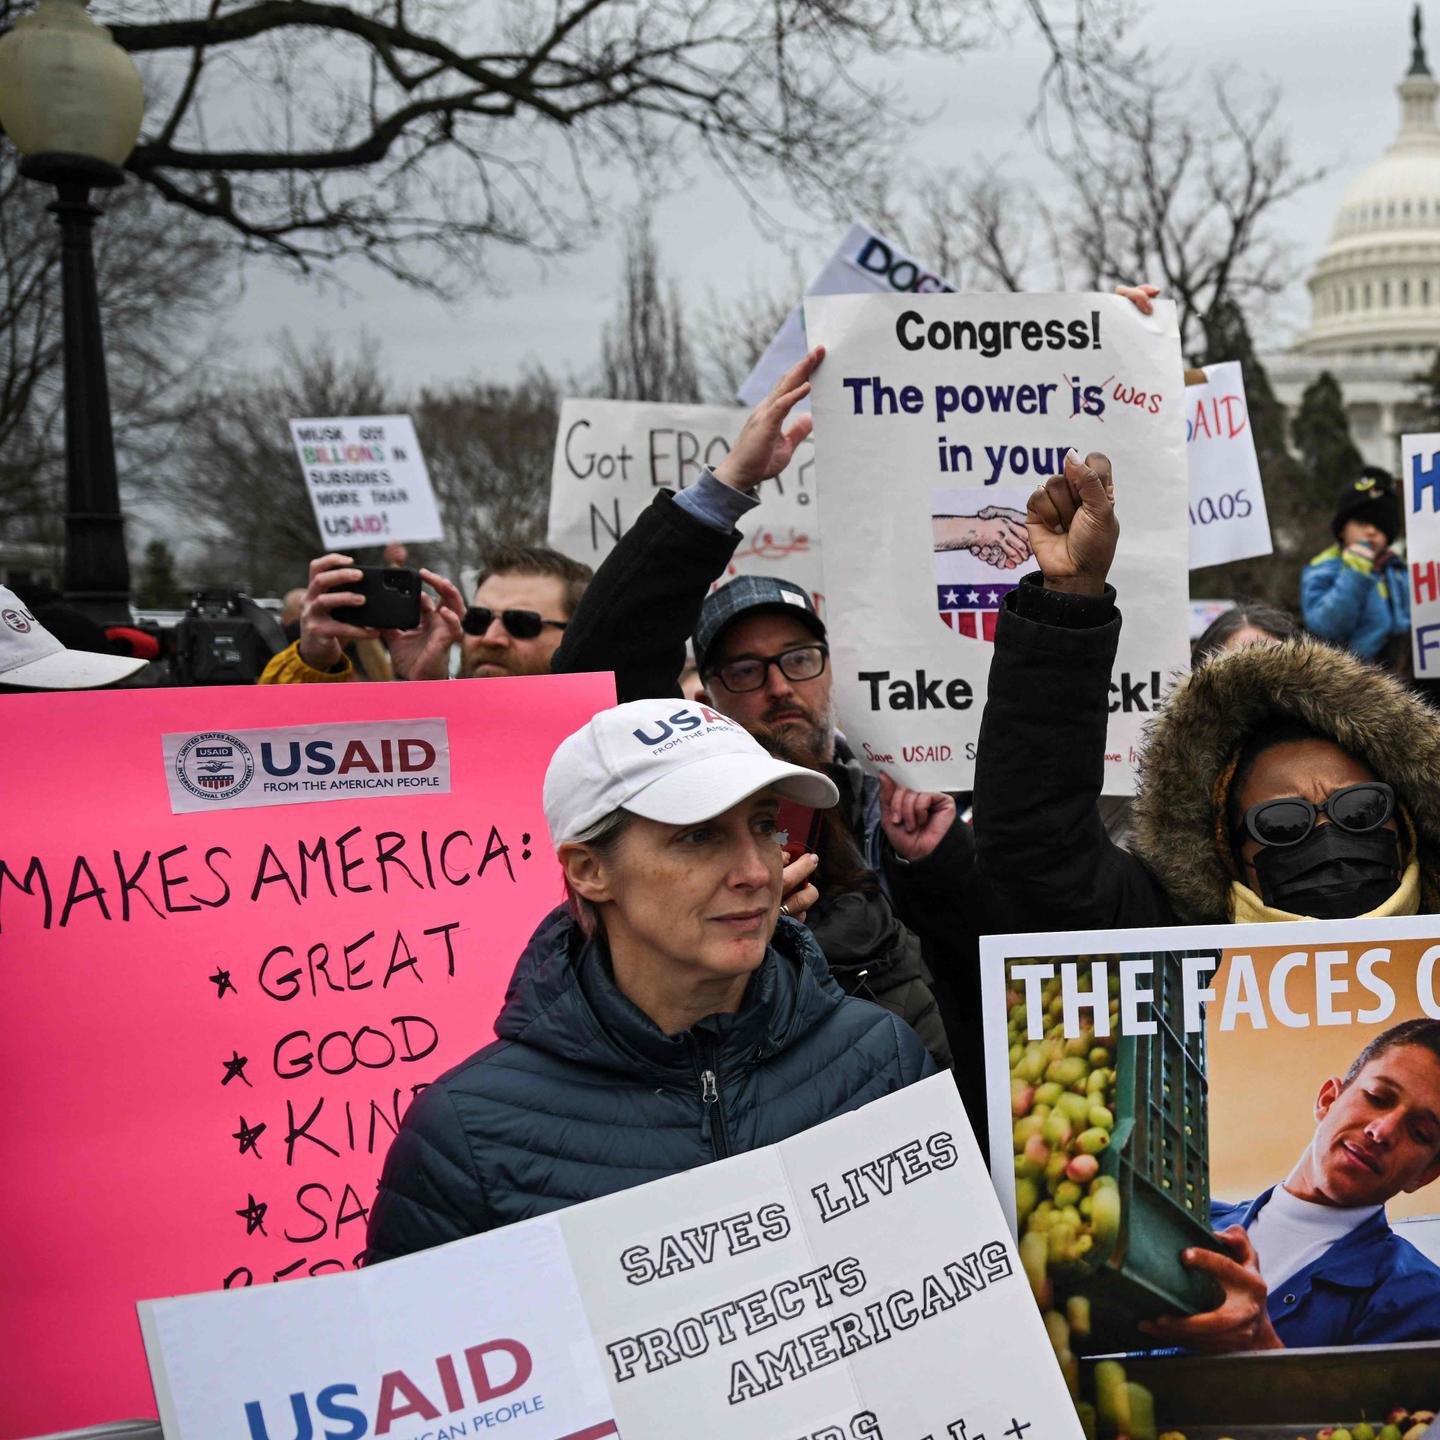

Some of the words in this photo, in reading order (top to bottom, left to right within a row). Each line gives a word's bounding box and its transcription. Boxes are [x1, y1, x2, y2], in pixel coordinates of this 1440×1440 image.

[856, 237, 958, 294] DOG
[896, 311, 1101, 358] Congress!
[843, 376, 924, 416] The
[935, 384, 1057, 423] power
[1072, 377, 1106, 417] is
[1113, 383, 1163, 414] was
[298, 427, 342, 441] MUSK
[303, 446, 385, 464] BILLIONS
[565, 420, 634, 479] Got
[310, 470, 392, 485] SUBSIDIES
[938, 436, 973, 472] in
[984, 445, 1079, 486] your
[316, 491, 361, 507] MORE
[371, 489, 409, 503] THAN
[324, 511, 389, 537] USAID!
[858, 669, 973, 712] Take
[180, 738, 200, 757] UNITED
[199, 733, 225, 742] STATES
[225, 736, 249, 755] AGENCY
[200, 748, 229, 756] USAID
[260, 738, 437, 777] USAID
[652, 737, 683, 756] FROM
[683, 730, 705, 742] THE
[862, 742, 895, 765] Save
[177, 767, 220, 799] INTERNATIONAL
[220, 765, 252, 799] DEVELOPMENT
[263, 781, 299, 792] FROM
[303, 780, 327, 791] THE
[329, 779, 396, 790] AMERICAN
[397, 776, 440, 787] PEOPLE
[0, 845, 231, 933] MAKES
[250, 825, 533, 905] AMERICA:
[258, 922, 461, 1001] GREAT
[1010, 958, 1158, 1040] THE
[1181, 947, 1398, 1033] FACES
[273, 1016, 439, 1080] GOOD
[284, 1083, 432, 1166] KIN
[621, 1202, 791, 1286] SAVES
[812, 1131, 959, 1223] LIVES
[606, 1256, 867, 1382] PROTECTS
[728, 1241, 1013, 1405] AMERICANS
[244, 1337, 534, 1440] USAID
[473, 1396, 544, 1432] PEOPLE
